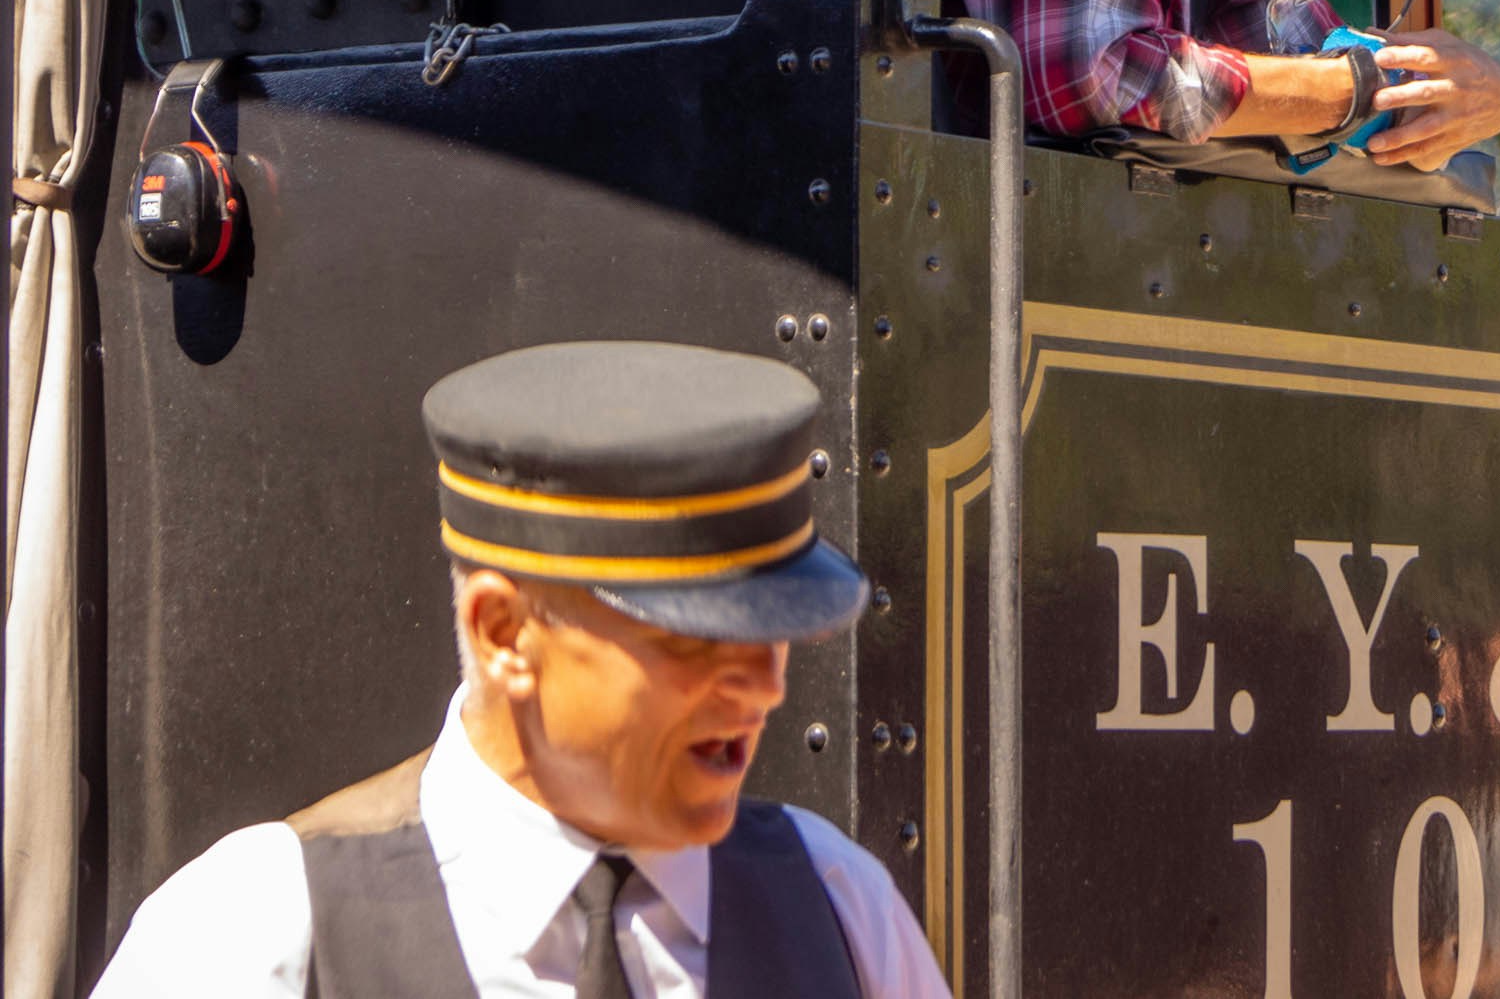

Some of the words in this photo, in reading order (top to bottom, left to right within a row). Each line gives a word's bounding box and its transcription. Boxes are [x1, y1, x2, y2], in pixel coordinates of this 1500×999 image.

[142, 175, 166, 192] 3M
[1095, 531, 1256, 736] E.
[1293, 539, 1432, 737] Y.
